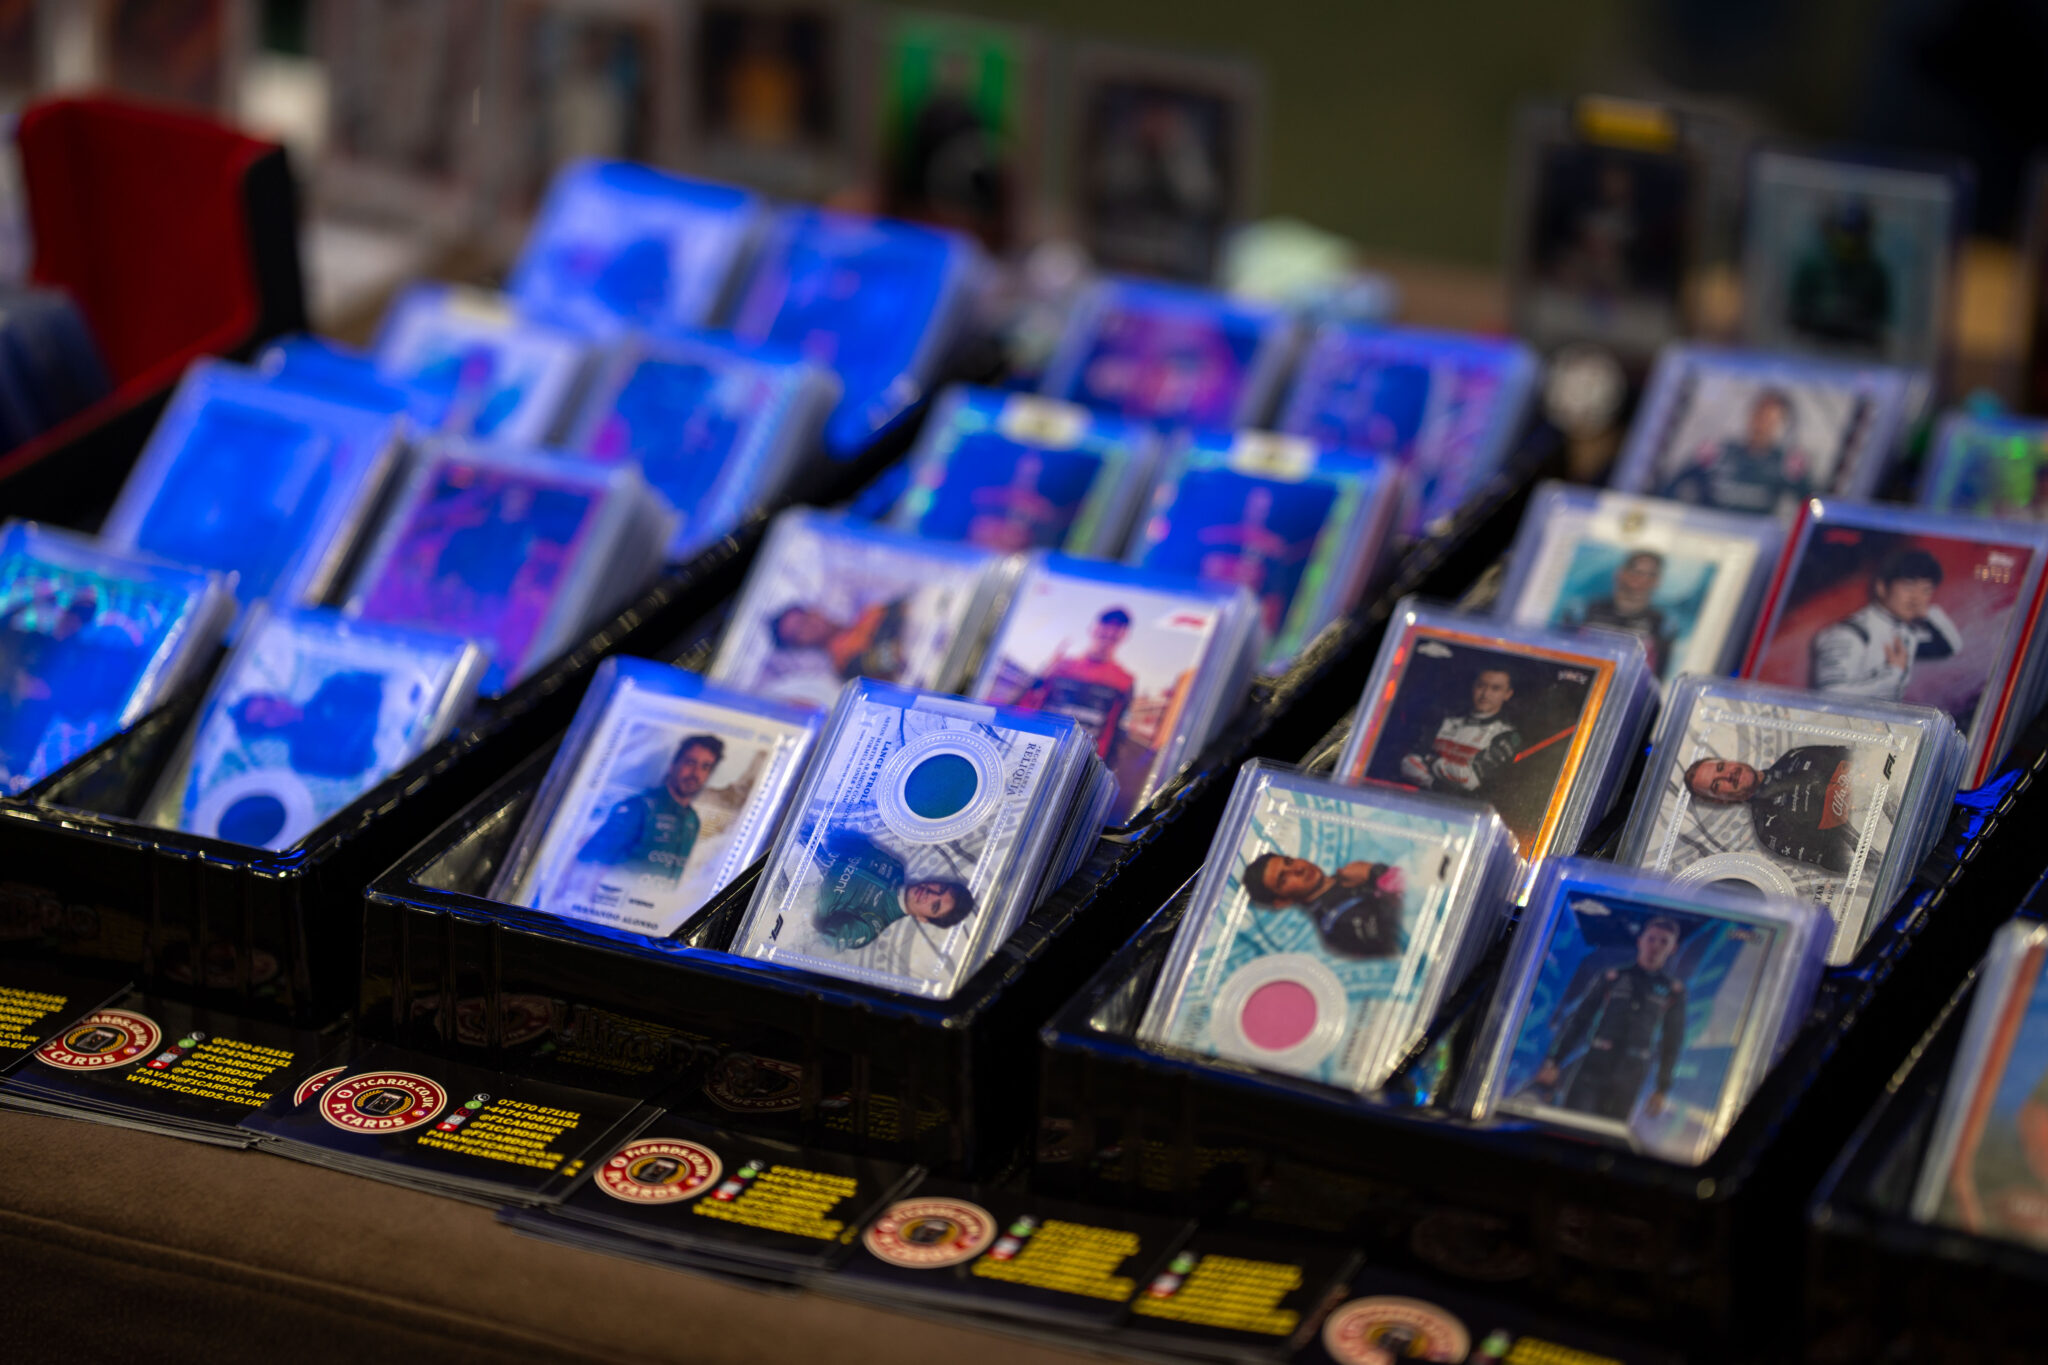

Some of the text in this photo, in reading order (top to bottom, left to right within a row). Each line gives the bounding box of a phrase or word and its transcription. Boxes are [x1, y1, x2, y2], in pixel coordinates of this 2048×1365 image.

[879, 715, 892, 737] ASTON
[858, 736, 876, 766] FORMULA
[868, 737, 883, 762] MARTIN
[855, 762, 870, 789] ARAMCO
[857, 740, 892, 805] LANCE STROLL
[1007, 743, 1037, 795] RELIQUIA
[842, 785, 853, 804] TEAM
[50, 1051, 116, 1065] CARDS
[197, 1043, 292, 1068] +447470871151
[212, 1036, 295, 1060] 07470 871151
[181, 1059, 267, 1081] @F1CARDSUK
[191, 1052, 276, 1074] @F1CARDSUK
[135, 1067, 273, 1100] PAVAN@F1CARDS.CO.UK
[171, 1066, 257, 1088] @F1CARDSUK
[126, 1074, 265, 1107] WWW.F1CARDS.CO.UK
[351, 1078, 434, 1108] F1CARDS.CO.UK
[331, 1103, 406, 1128] F1 CARDS
[483, 1104, 580, 1129] +447470871151
[497, 1098, 581, 1120] 07470 871151
[469, 1121, 556, 1143] @F1CARDSUK
[479, 1113, 565, 1135] @F1CARDSUK
[425, 1129, 565, 1162] PAVAN@F1CARDS.CO.UK
[460, 1128, 547, 1150] @F1CARDSUK
[417, 1135, 558, 1170] WWW.F1CARDS.CO.UK
